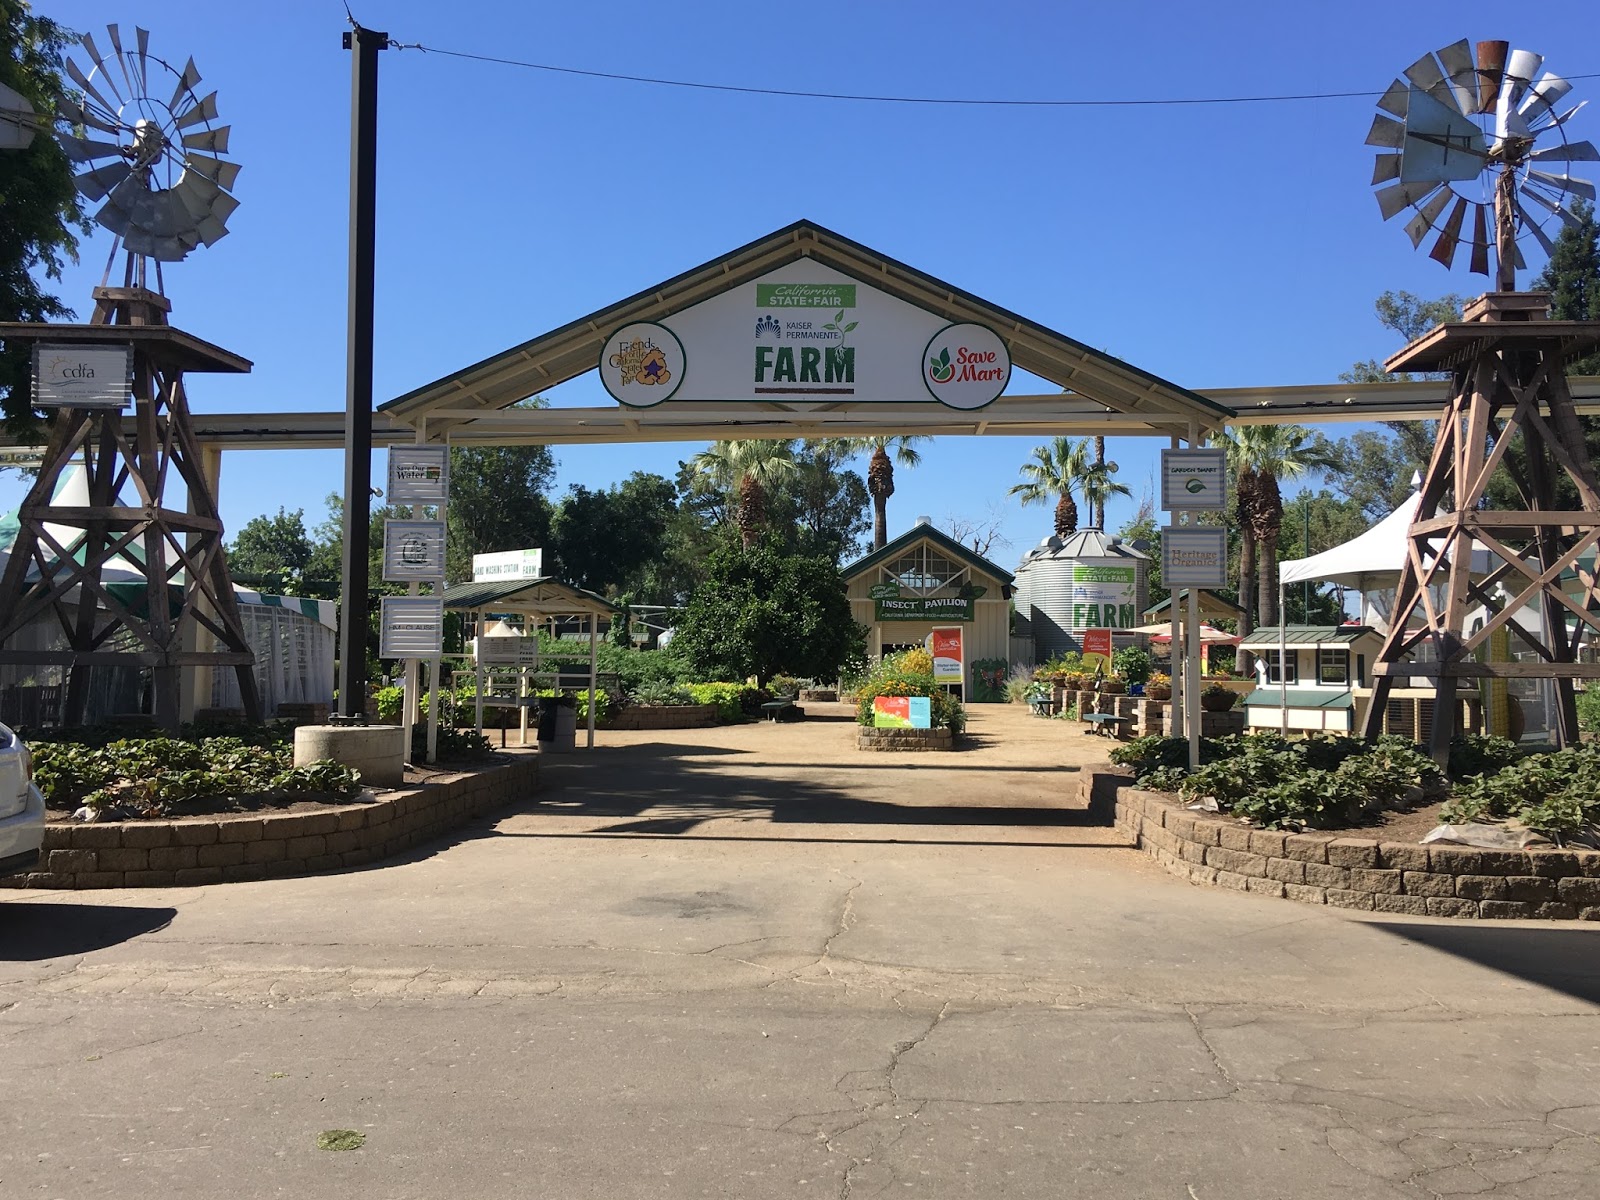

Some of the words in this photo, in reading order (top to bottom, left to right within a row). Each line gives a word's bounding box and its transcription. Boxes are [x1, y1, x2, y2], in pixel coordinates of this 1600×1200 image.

[775, 284, 837, 296] California
[769, 296, 807, 306] STATE
[813, 297, 842, 306] FAIR
[786, 321, 812, 330] KAISER
[786, 331, 839, 340] PERMANENTE
[619, 337, 656, 358] Friends
[956, 346, 998, 365] Save
[755, 346, 856, 384] FARM
[956, 364, 1005, 383] Mart
[396, 471, 425, 480] Water
[1171, 549, 1218, 560] Heritage
[1171, 557, 1217, 567] Organics
[882, 600, 919, 609] INSECT
[924, 598, 968, 609] PAVILION
[1073, 603, 1135, 628] FARM
